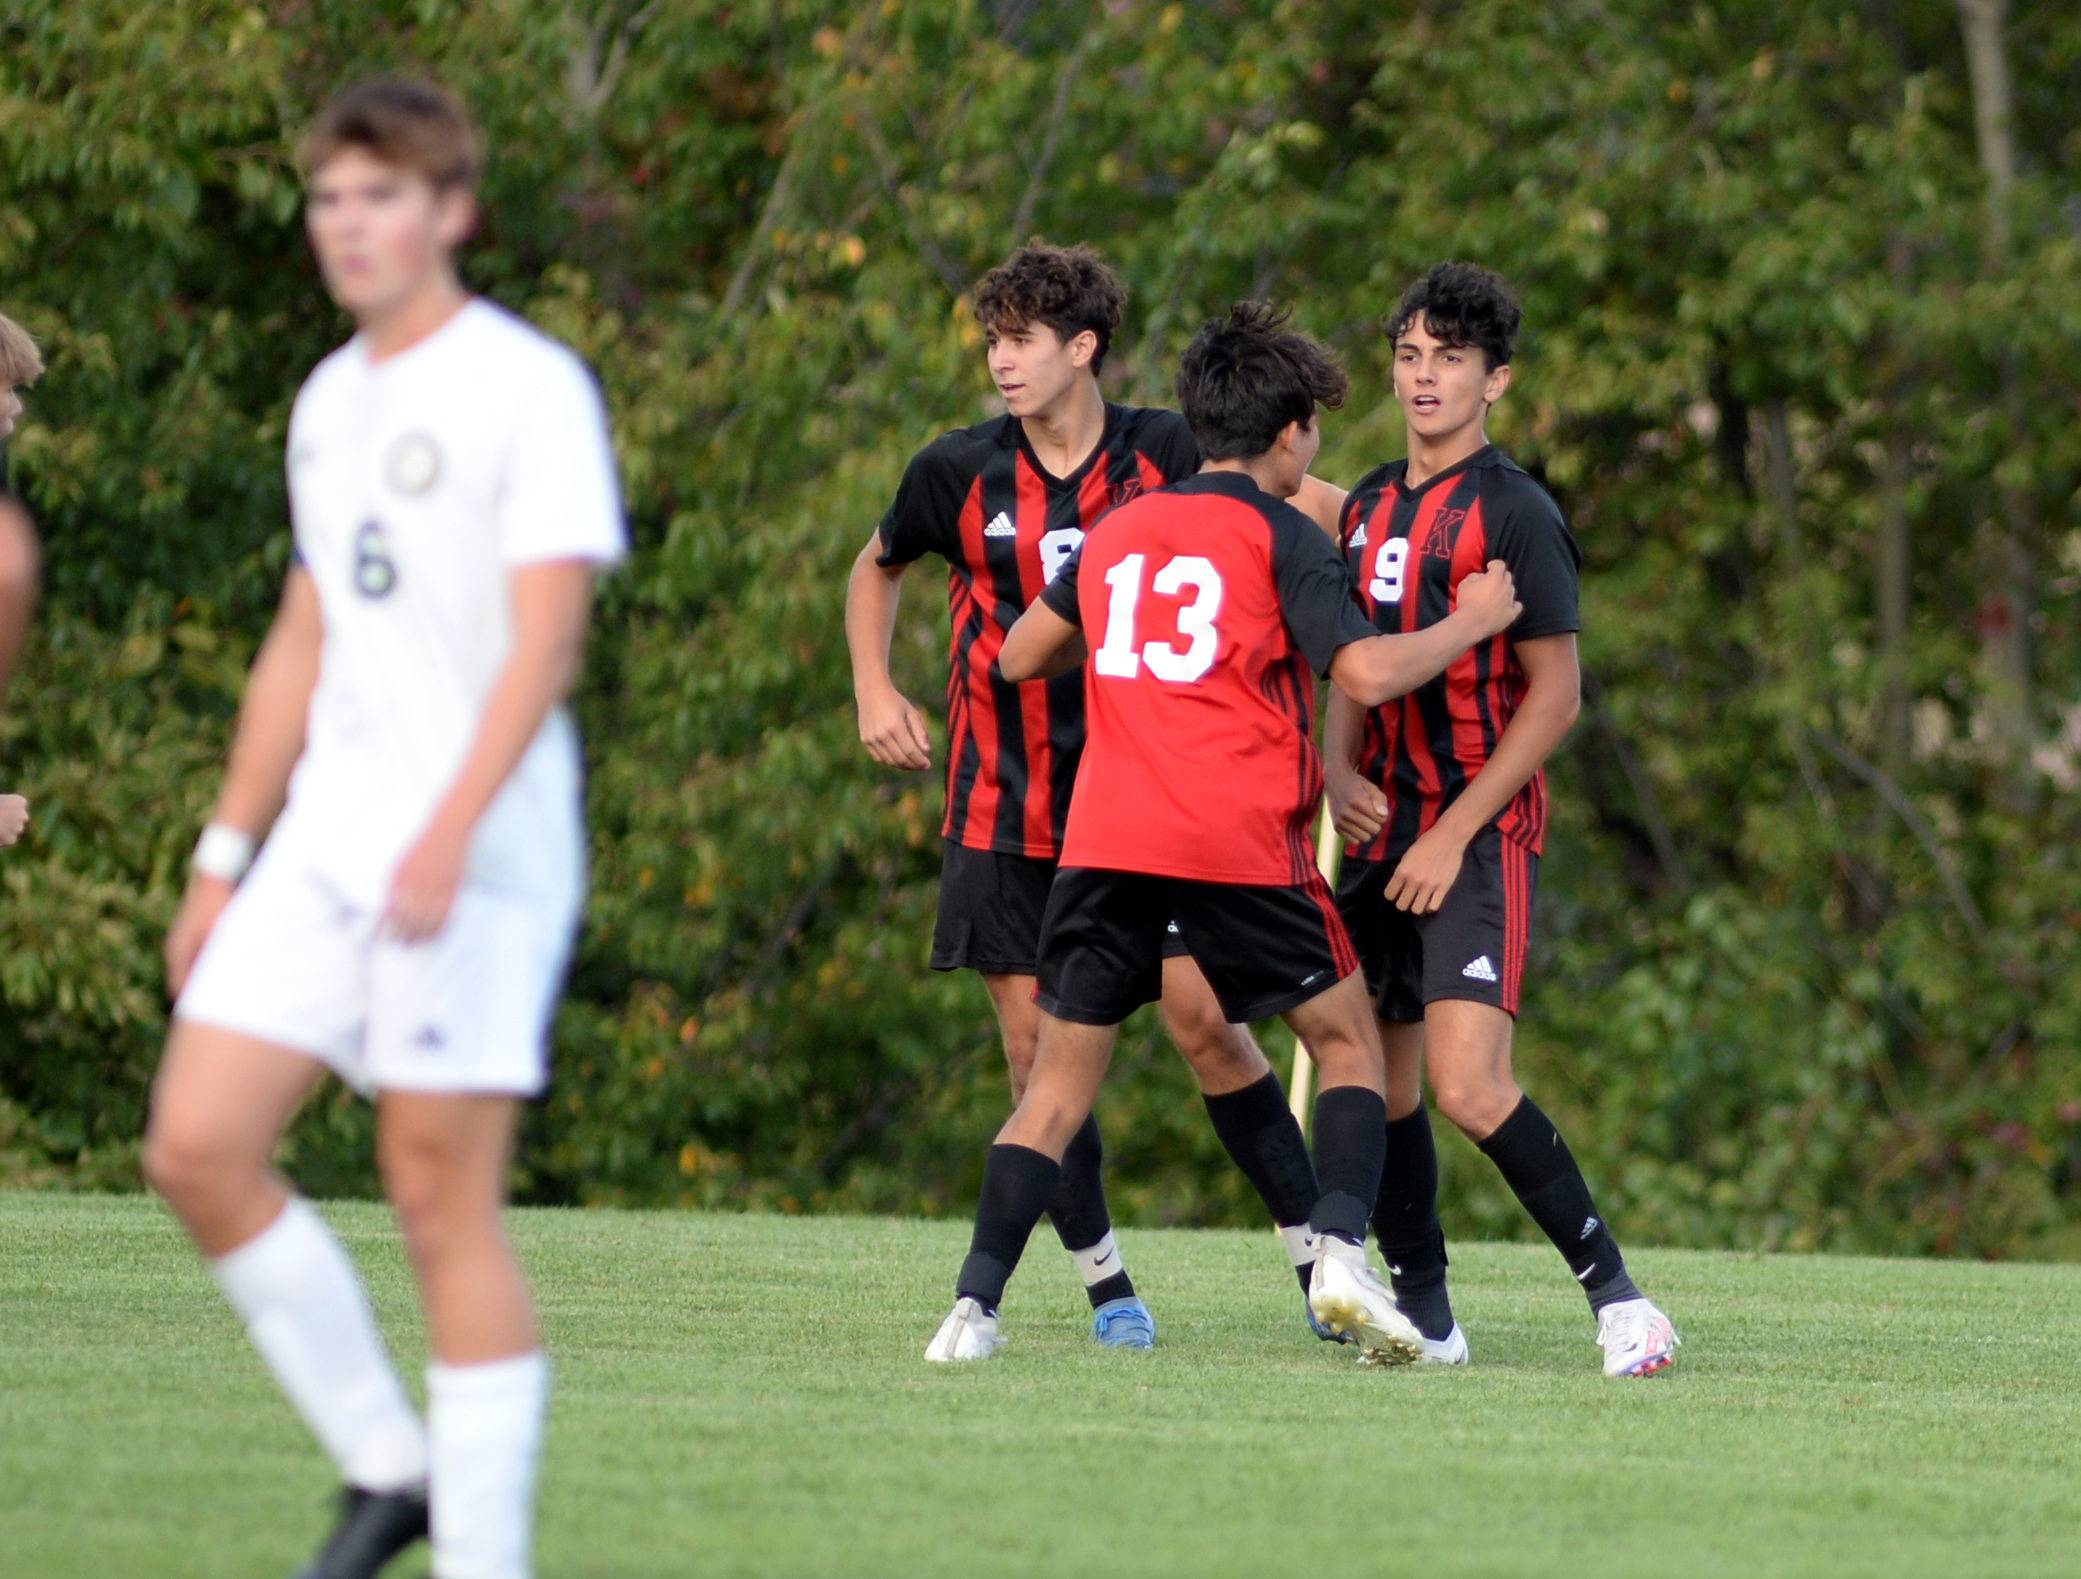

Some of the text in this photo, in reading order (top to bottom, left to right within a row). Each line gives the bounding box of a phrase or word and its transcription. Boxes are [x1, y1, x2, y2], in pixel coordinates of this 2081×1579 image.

[353, 519, 398, 600] 6
[1369, 537, 1409, 601] 9
[1420, 507, 1466, 559] K
[1095, 553, 1222, 683] 13
